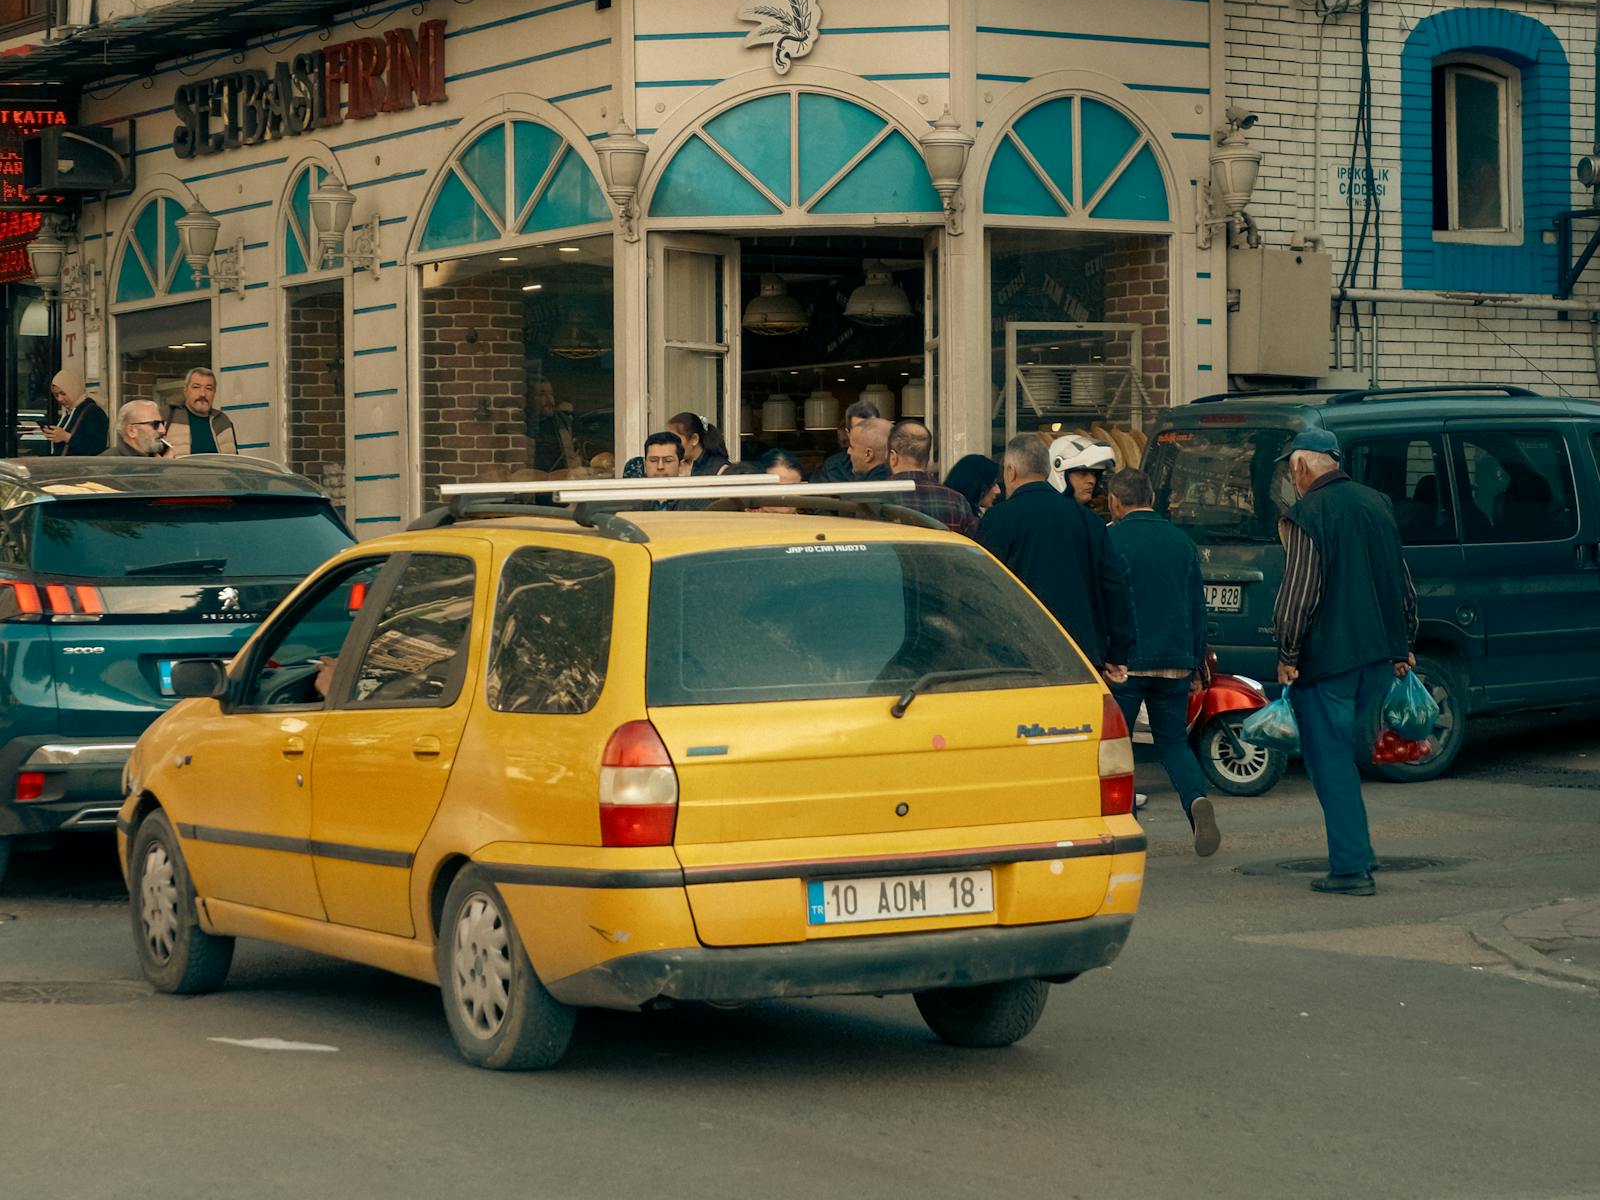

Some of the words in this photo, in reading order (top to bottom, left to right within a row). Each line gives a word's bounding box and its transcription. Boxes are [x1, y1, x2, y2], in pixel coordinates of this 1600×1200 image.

[13, 110, 67, 125] KATTA
[1221, 588, 1239, 606] 828
[831, 884, 858, 916] 10
[877, 879, 927, 914] AOM
[949, 876, 975, 908] 18
[812, 905, 824, 915] TR
